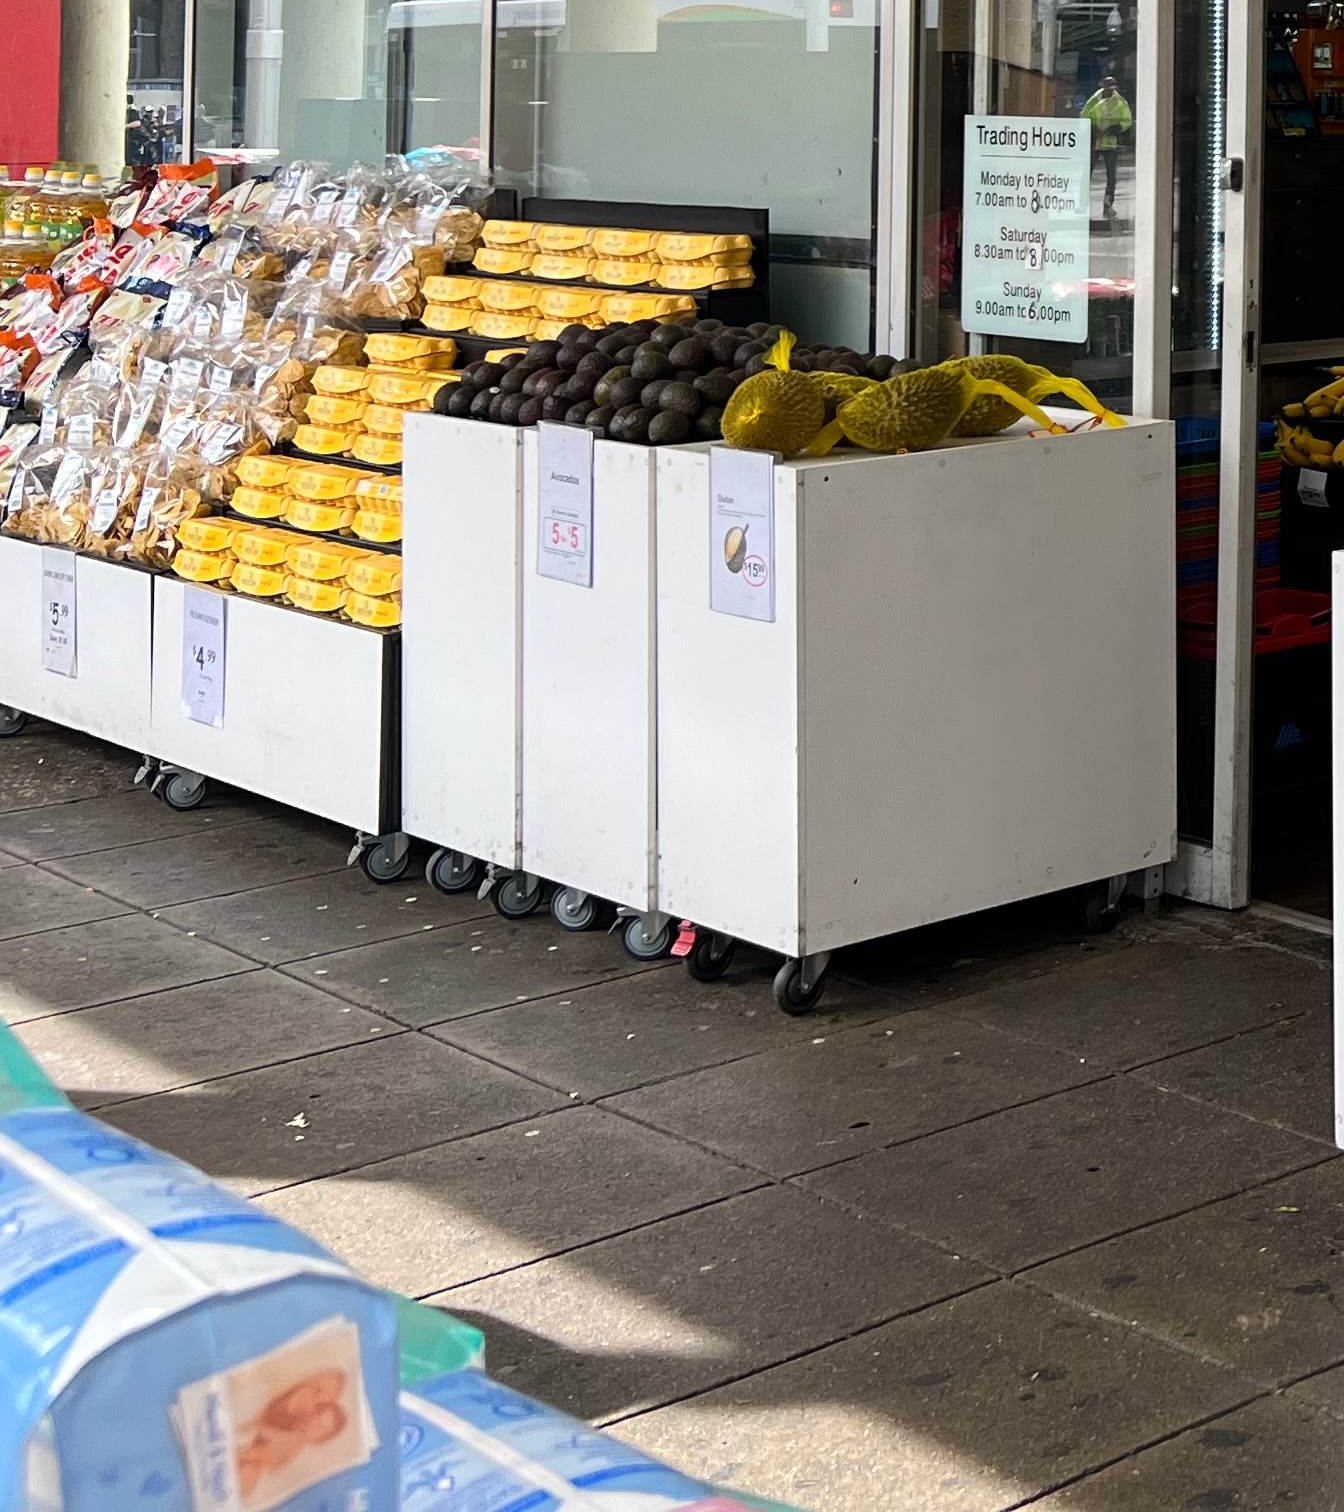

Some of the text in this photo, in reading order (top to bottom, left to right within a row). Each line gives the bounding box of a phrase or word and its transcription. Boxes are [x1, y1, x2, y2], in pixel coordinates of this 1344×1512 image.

[977, 125, 1076, 151] Trading Hours
[980, 171, 1069, 189] Monday to Friday
[975, 190, 1075, 213] 7.00am to 8.00pm
[1000, 227, 1047, 244] Saturday
[974, 244, 1013, 261] 8.30am
[1003, 282, 1042, 299] Sunday
[975, 300, 1014, 318] 9.00am
[1028, 302, 1071, 322] 6.00pm
[551, 471, 580, 486] Avocados
[551, 522, 560, 545] 5
[193, 646, 217, 672] $4.99
